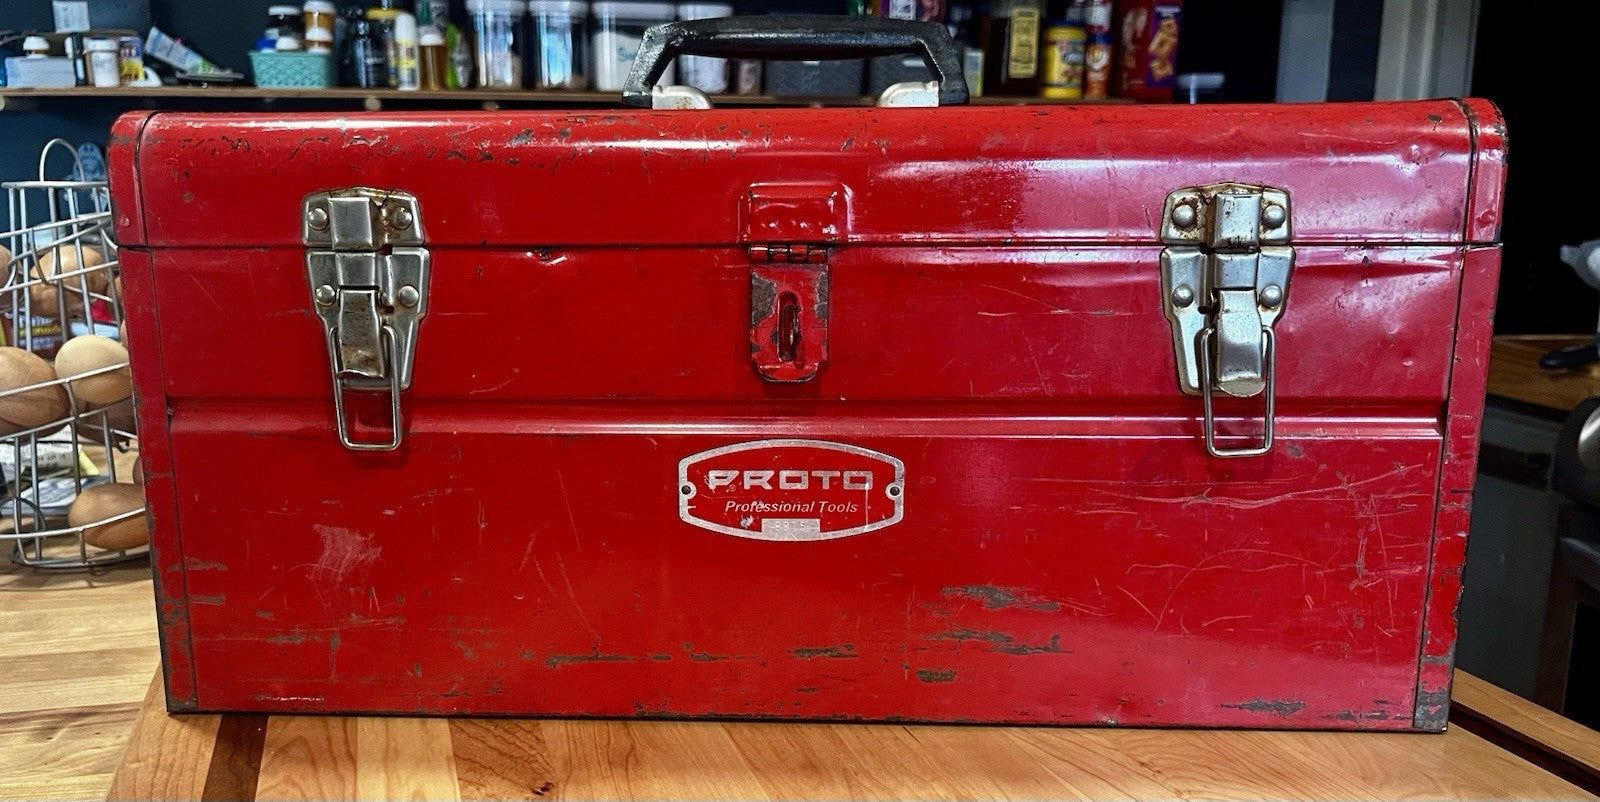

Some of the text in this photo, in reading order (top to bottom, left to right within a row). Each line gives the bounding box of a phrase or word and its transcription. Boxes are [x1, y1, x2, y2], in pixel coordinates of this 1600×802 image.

[707, 469, 874, 490] PROTO
[724, 500, 858, 513] Professional Tools
